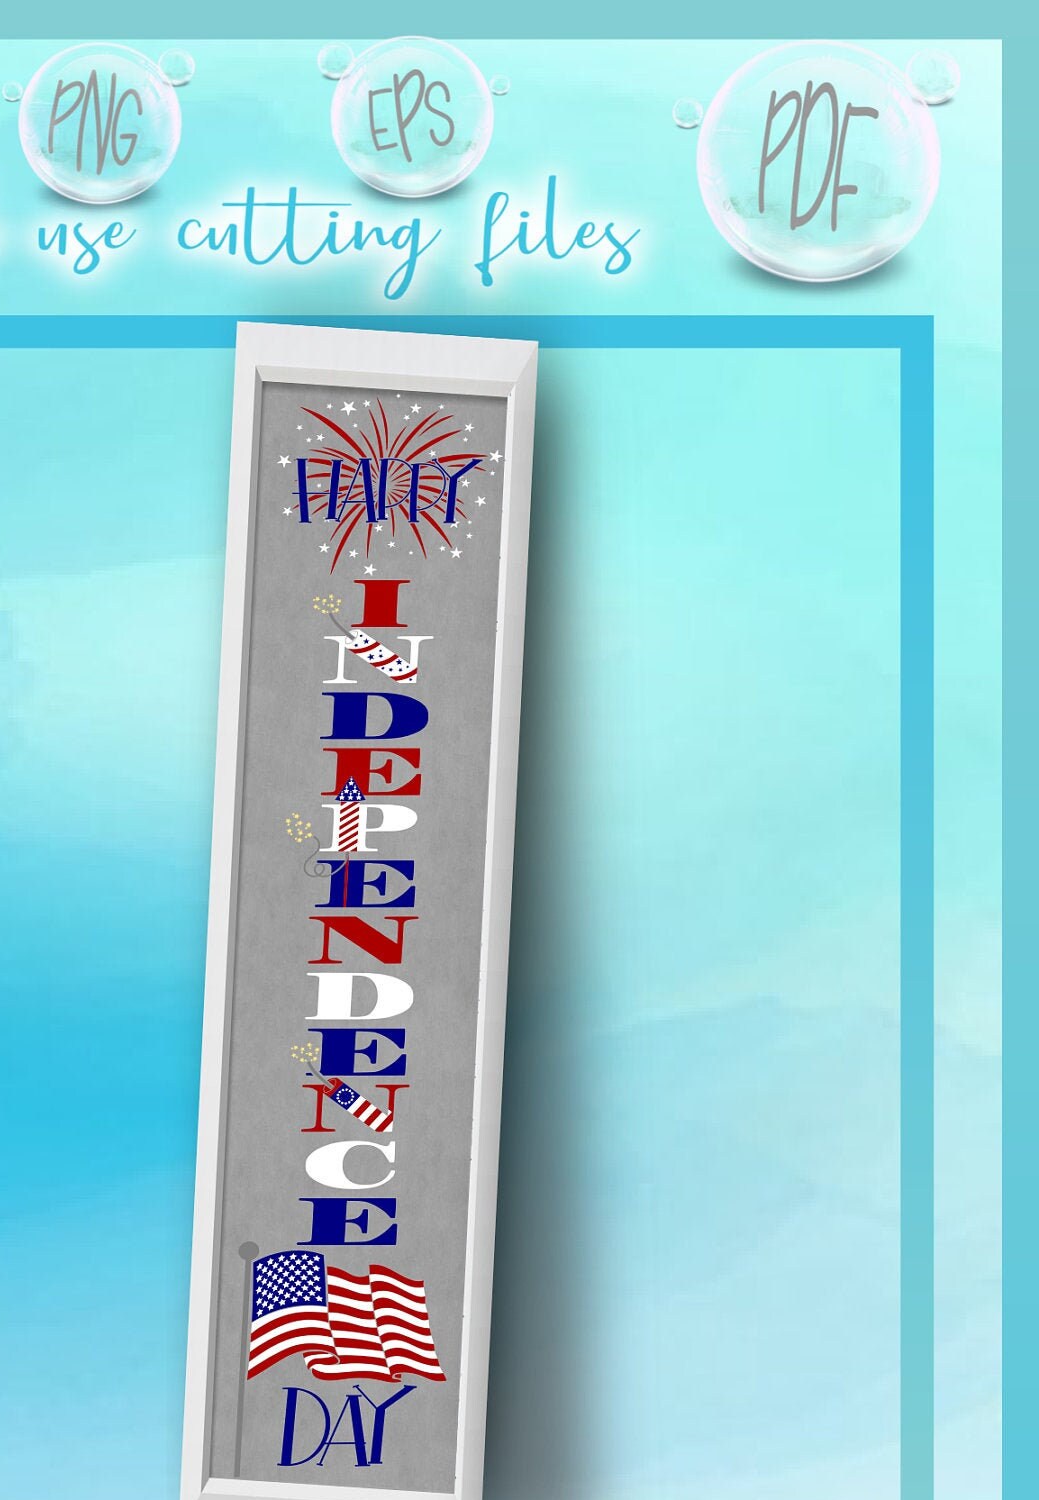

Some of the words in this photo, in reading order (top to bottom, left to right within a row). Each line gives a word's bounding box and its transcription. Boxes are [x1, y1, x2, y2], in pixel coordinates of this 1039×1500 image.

[291, 457, 484, 524] HAPPY
[296, 579, 434, 1246] INDEPENDENCE
[276, 1384, 417, 1466] DAY
